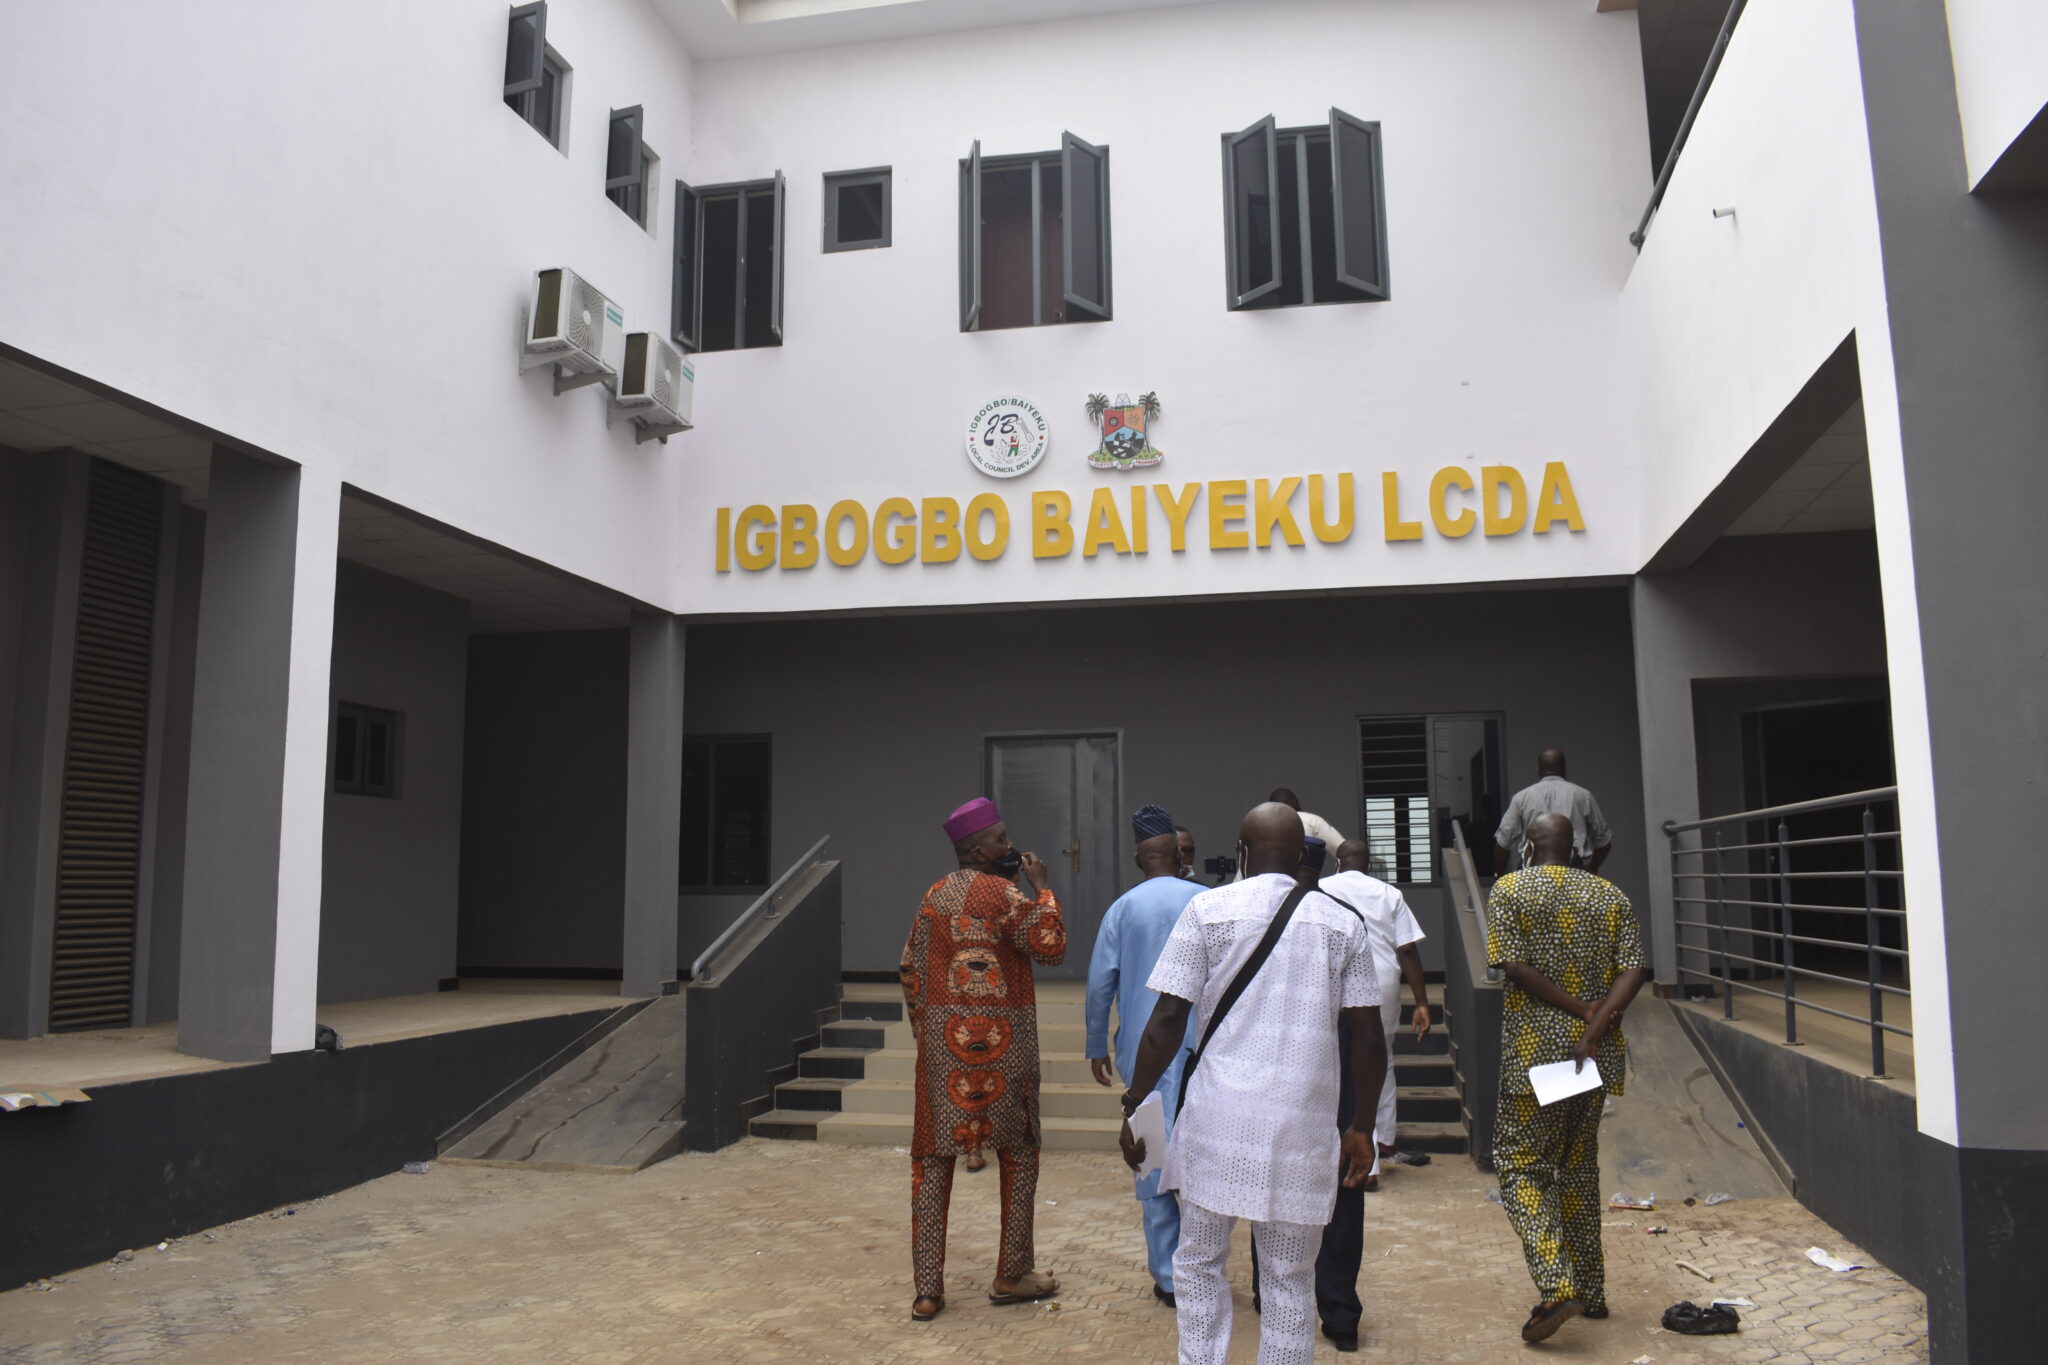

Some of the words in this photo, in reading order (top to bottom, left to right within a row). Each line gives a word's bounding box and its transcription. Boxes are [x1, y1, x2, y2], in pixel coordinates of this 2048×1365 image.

[969, 443, 983, 465] LOCAL
[983, 462, 1015, 473] COUNCIL
[1016, 459, 1032, 471] DEV.
[1031, 442, 1044, 461] AREA
[716, 492, 1010, 573] IGBOGBO
[1031, 472, 1356, 560] BAIYEKU
[1382, 461, 1587, 542] LCDA
